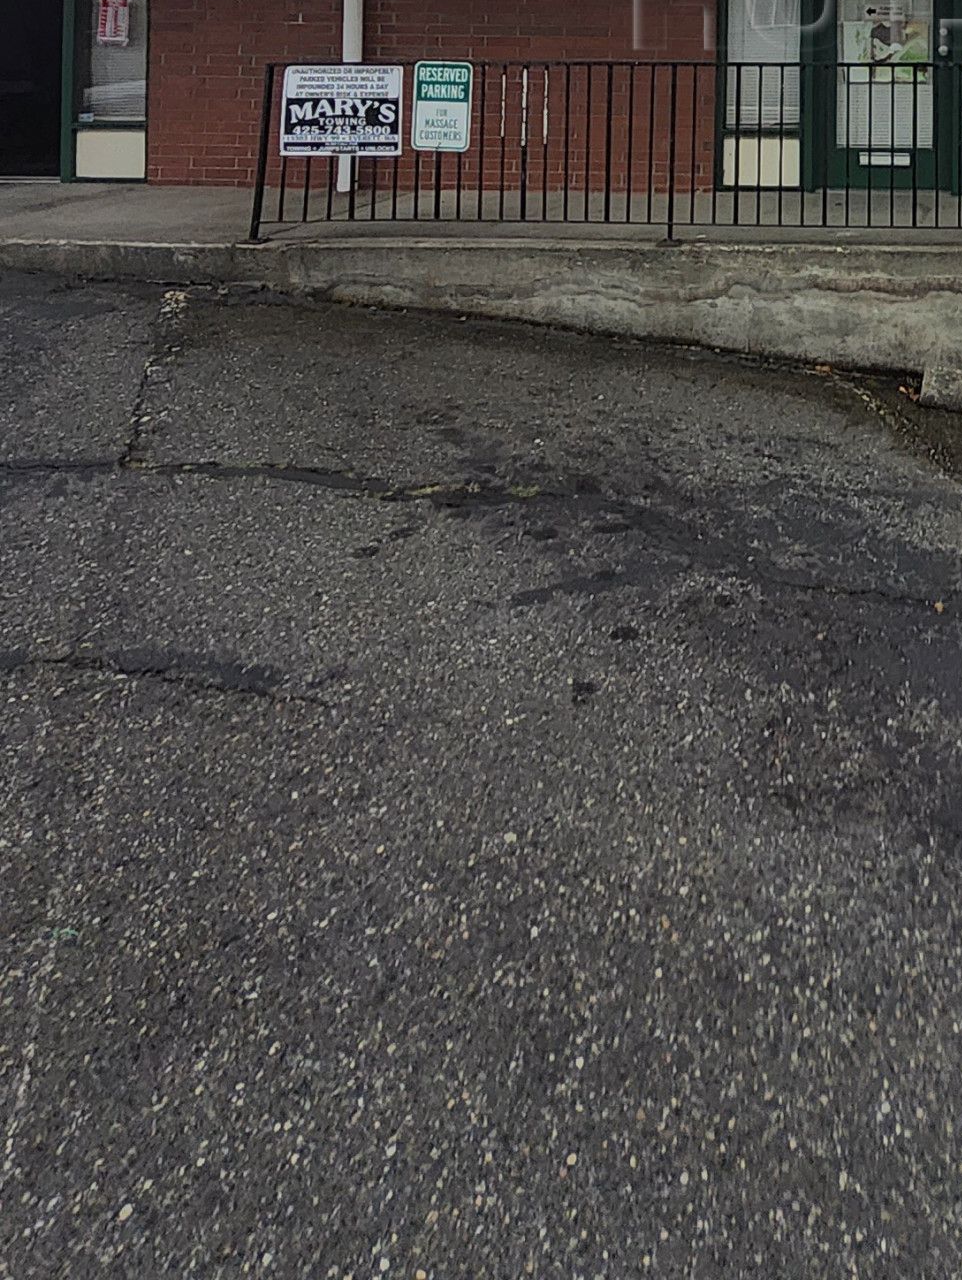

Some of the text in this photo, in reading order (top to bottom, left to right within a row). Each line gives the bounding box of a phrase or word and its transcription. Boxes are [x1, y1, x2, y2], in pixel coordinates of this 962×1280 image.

[418, 67, 469, 82] RESERVED
[421, 84, 465, 99] PARKING
[289, 99, 396, 124] MARY'S
[436, 108, 447, 116] FOR
[318, 117, 366, 126] TOWING
[425, 118, 458, 129] MASSAGE
[292, 125, 391, 135] 425-743-5800
[420, 130, 462, 141] CUSTOMERS
